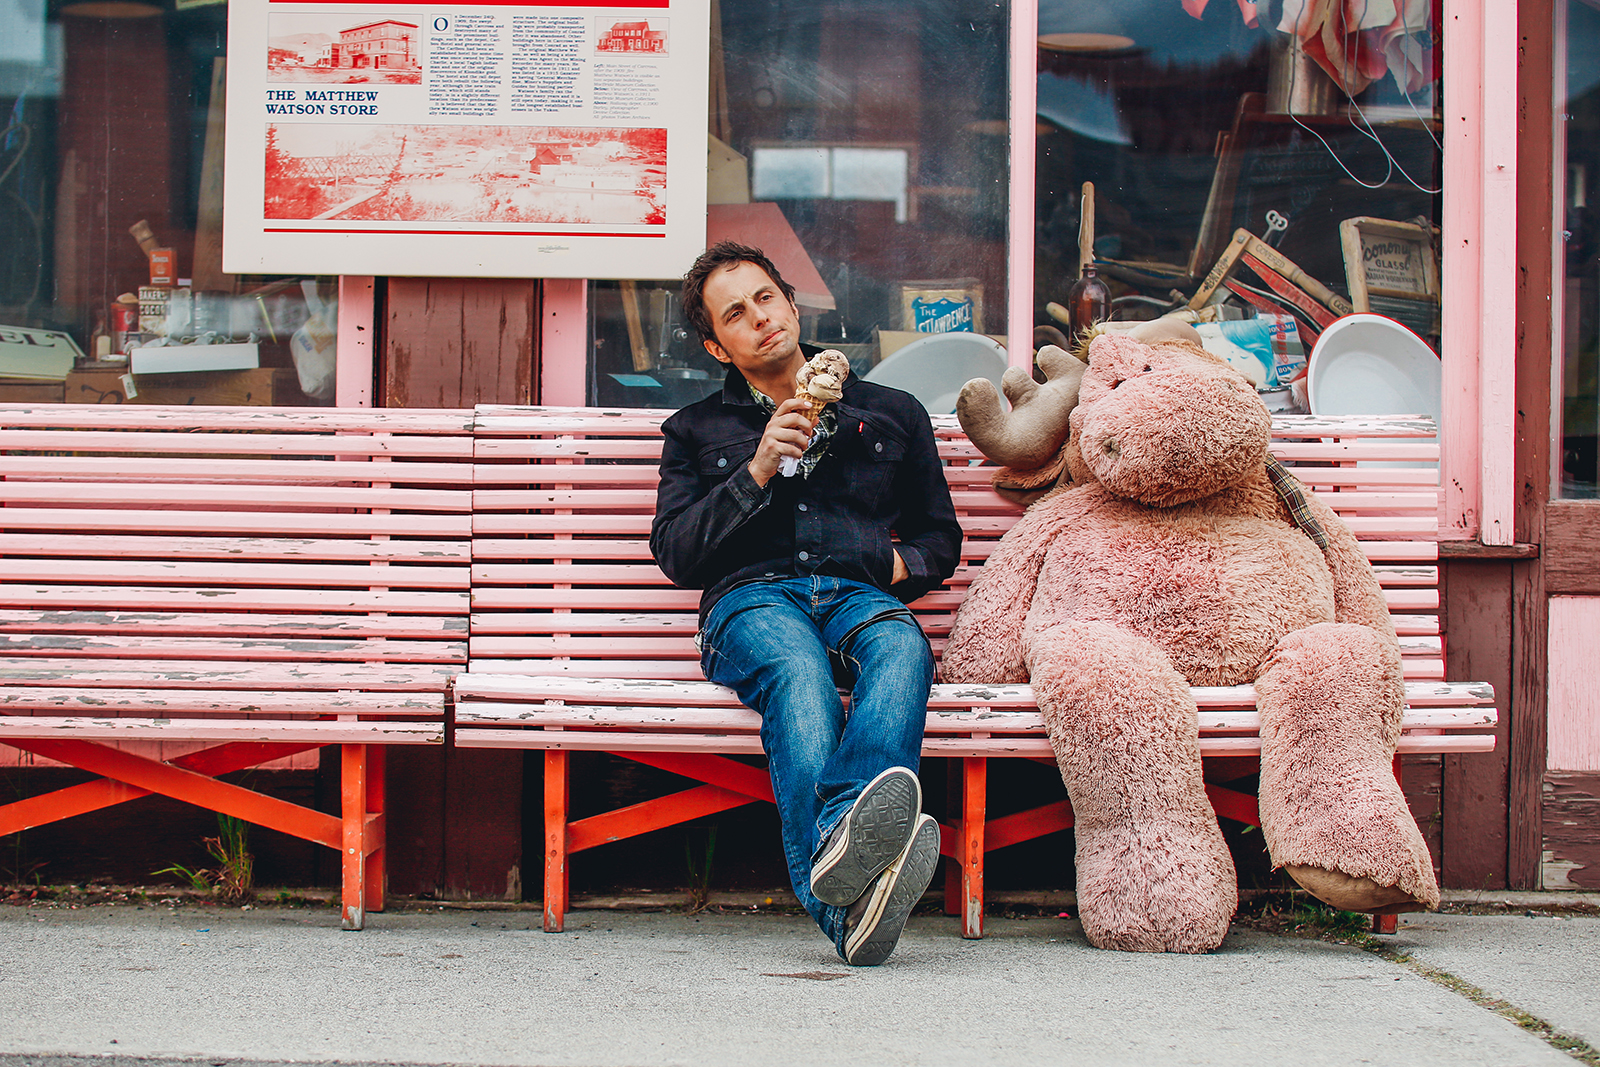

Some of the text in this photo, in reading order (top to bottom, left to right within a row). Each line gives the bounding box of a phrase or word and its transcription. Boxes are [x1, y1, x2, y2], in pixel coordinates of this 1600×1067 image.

[266, 90, 378, 101] THE MATTHEW
[266, 104, 378, 115] WATSON STORE
[1255, 244, 1286, 268] COVERED
[1376, 258, 1405, 270] GLASS
